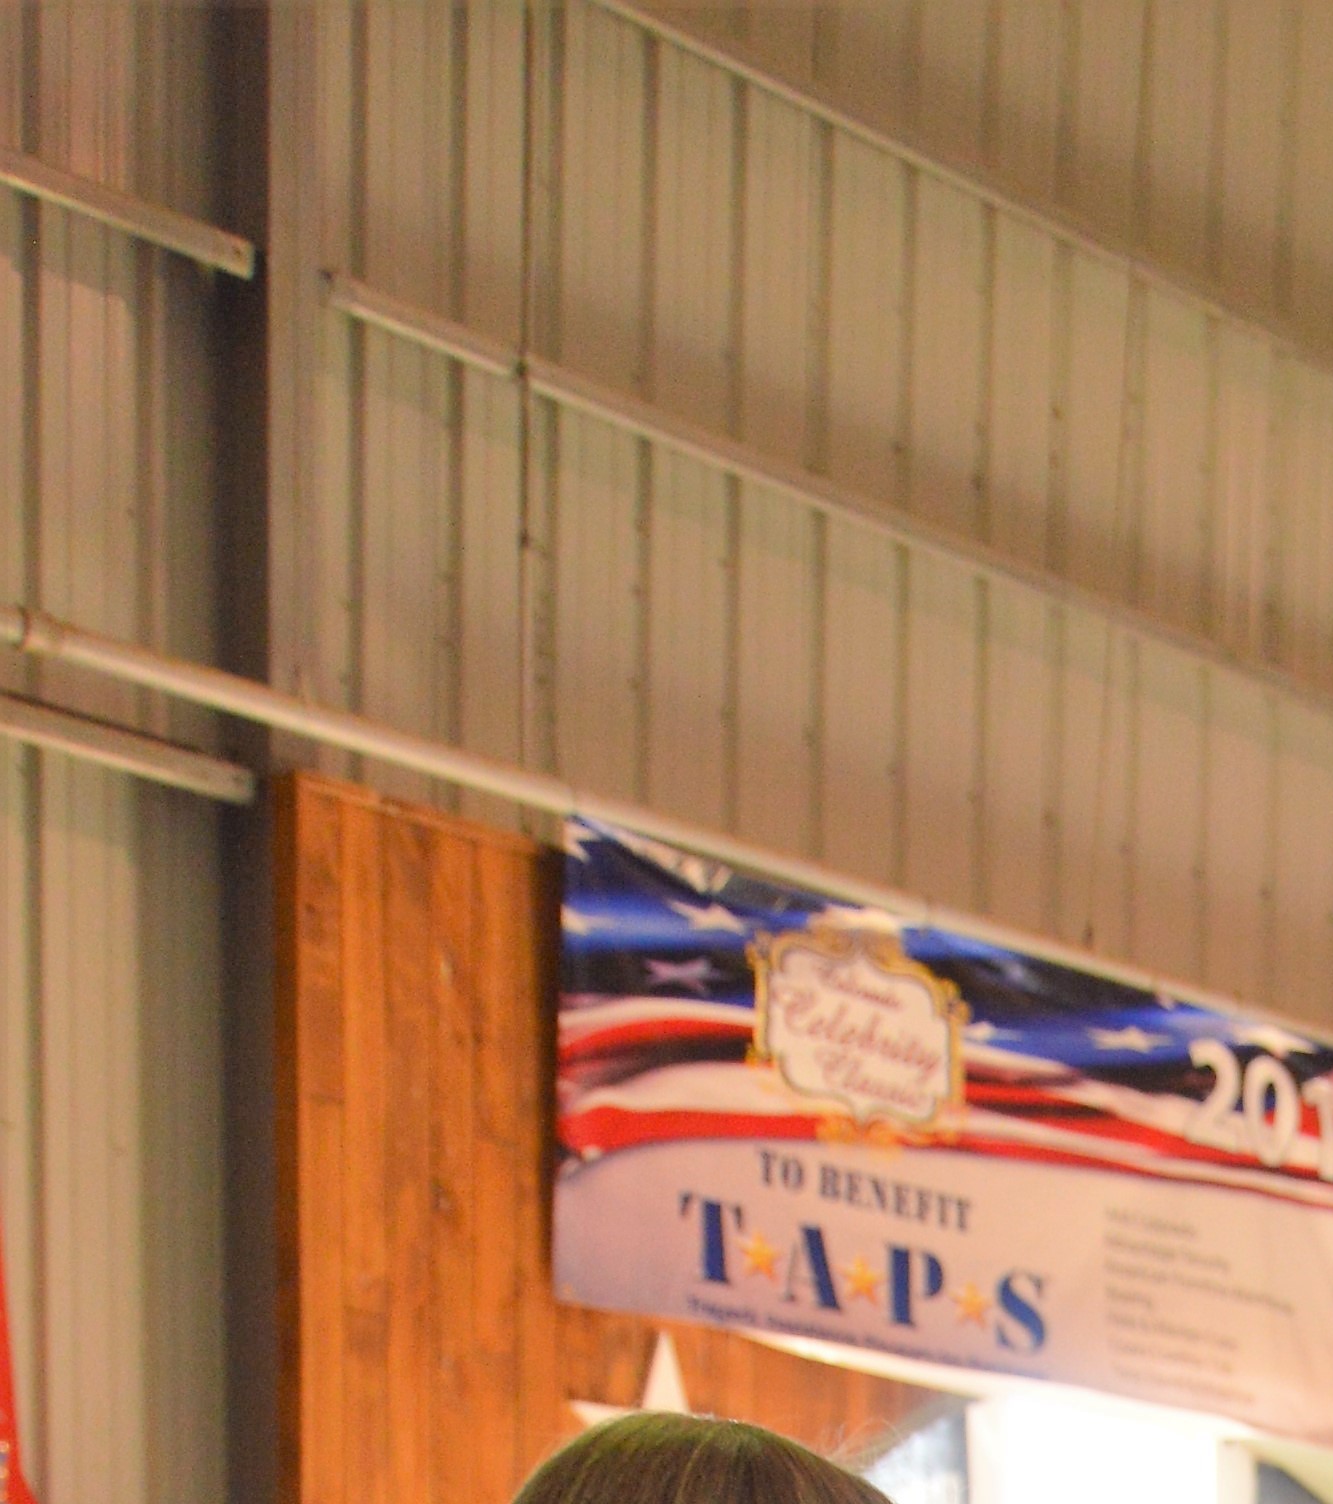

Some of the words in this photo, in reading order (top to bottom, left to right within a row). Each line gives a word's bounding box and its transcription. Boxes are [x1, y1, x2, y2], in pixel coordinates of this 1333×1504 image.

[778, 988, 941, 1084] Celebrity
[759, 1149, 804, 1189] TO
[818, 1163, 972, 1231] BENEFIT
